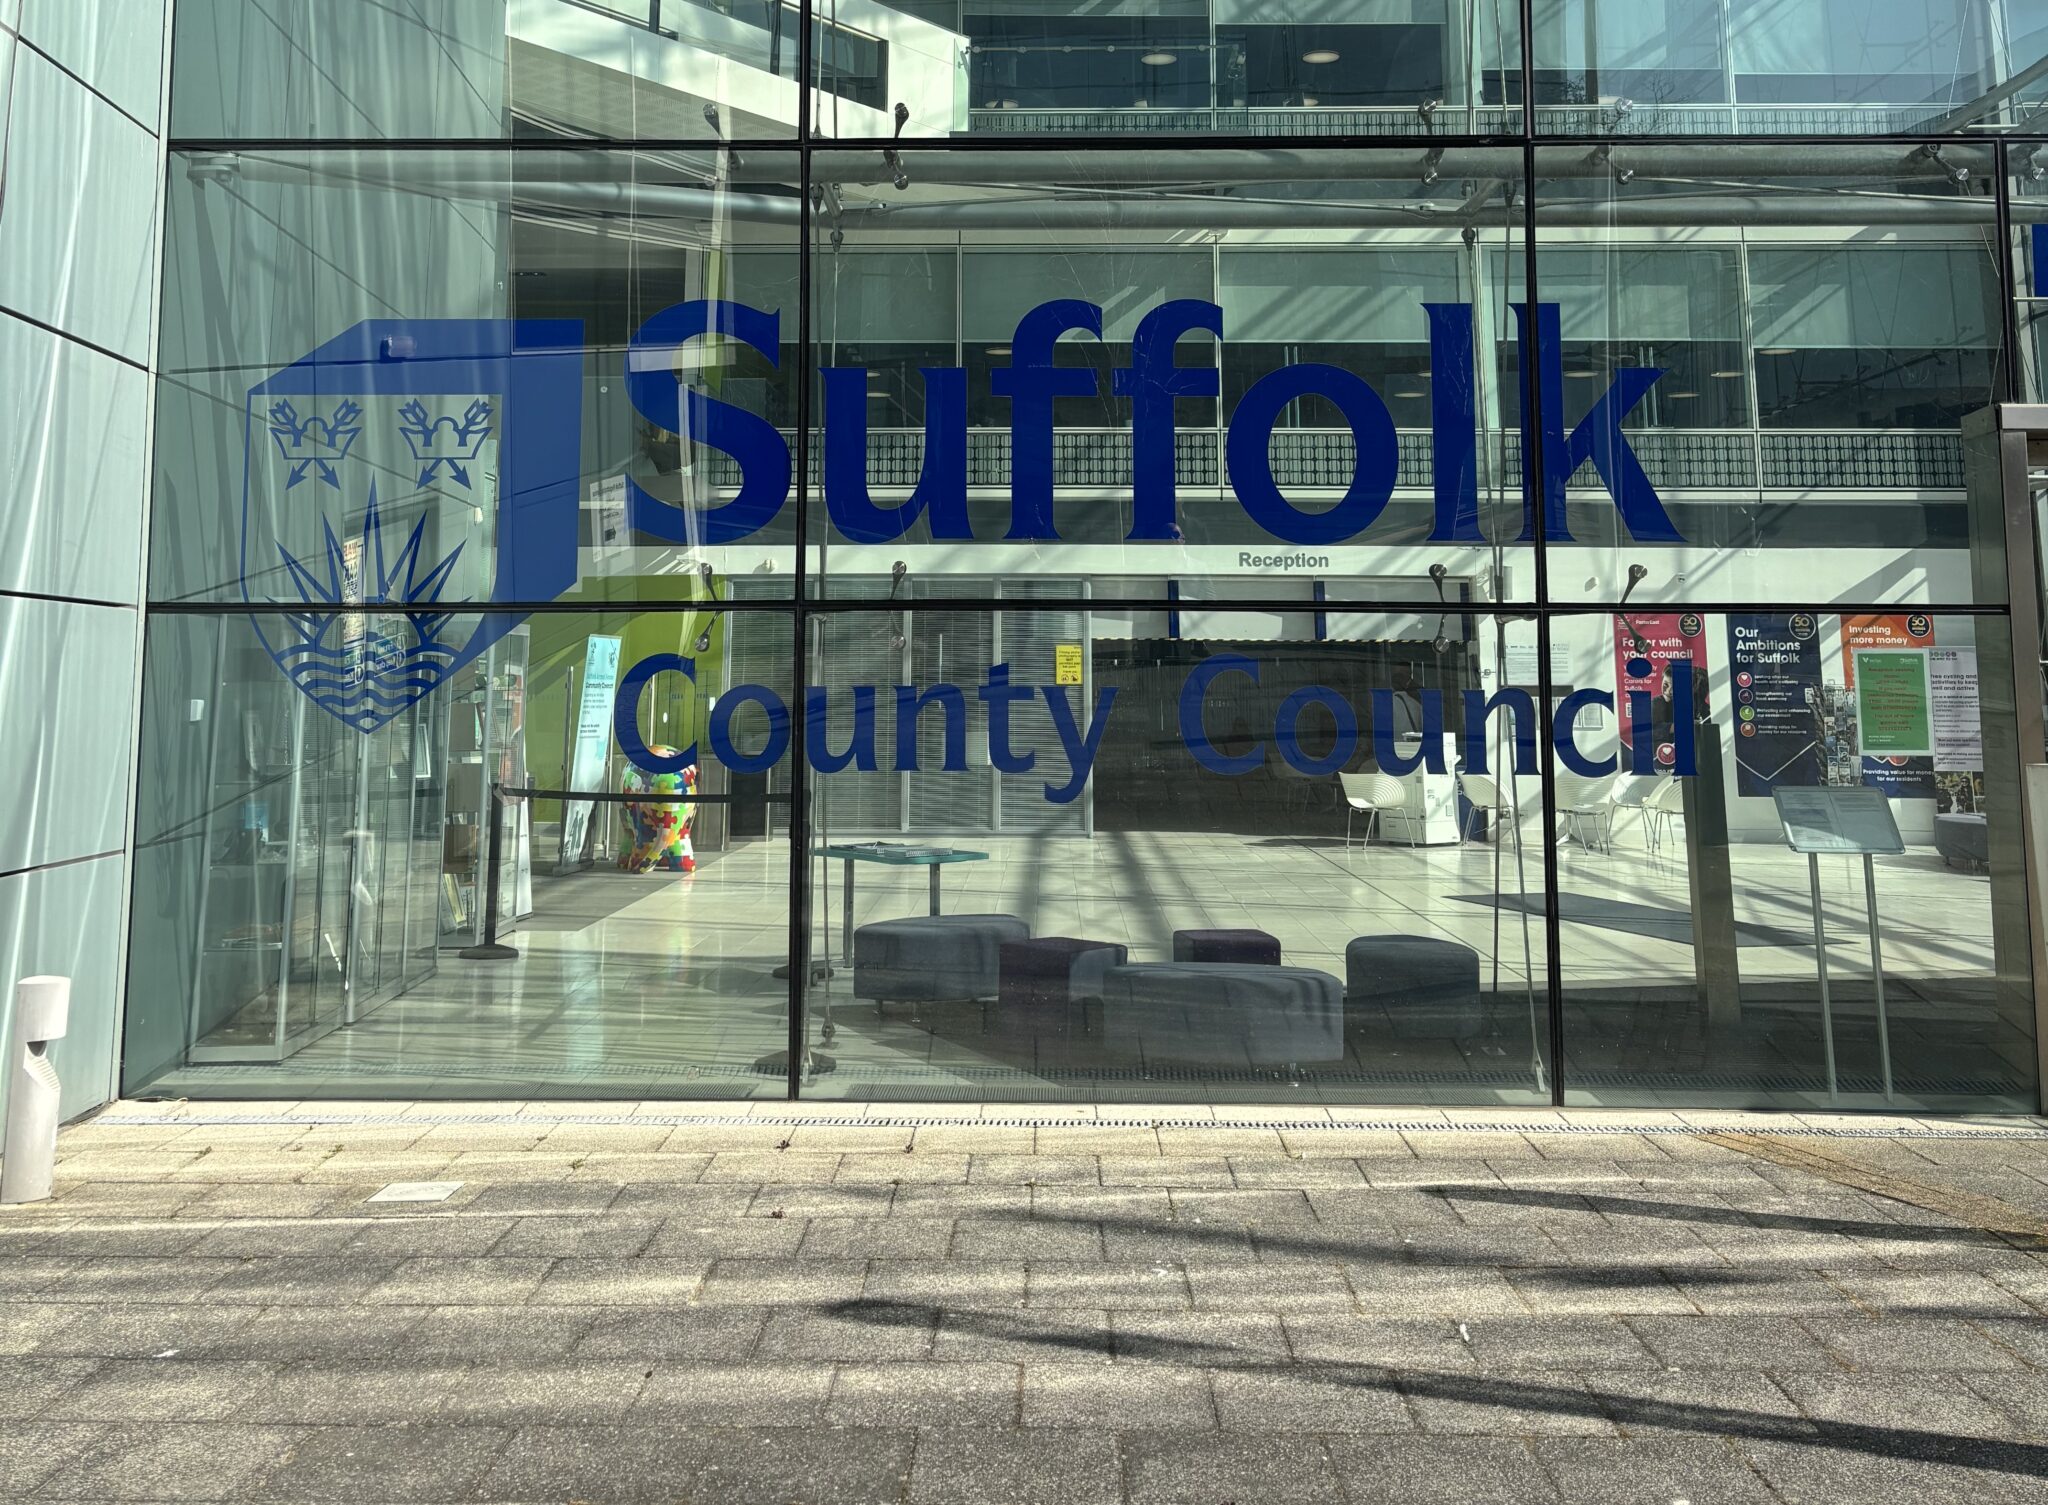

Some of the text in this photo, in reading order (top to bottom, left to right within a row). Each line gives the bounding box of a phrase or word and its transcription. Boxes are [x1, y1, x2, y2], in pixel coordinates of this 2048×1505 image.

[624, 299, 1689, 546] Suffolk
[1238, 551, 1329, 571] Reception
[1794, 616, 1809, 627] 50
[1911, 616, 1925, 626] 50
[1734, 626, 1758, 638] Our
[1848, 625, 1891, 636] Investing
[1658, 637, 1682, 647] with
[1735, 639, 1801, 651] Ambitions
[1876, 637, 1908, 646] money
[1650, 648, 1693, 659] council
[1736, 652, 1801, 664] for Suffolk
[614, 653, 1700, 804] County Council
[1862, 768, 1889, 776] Providing
